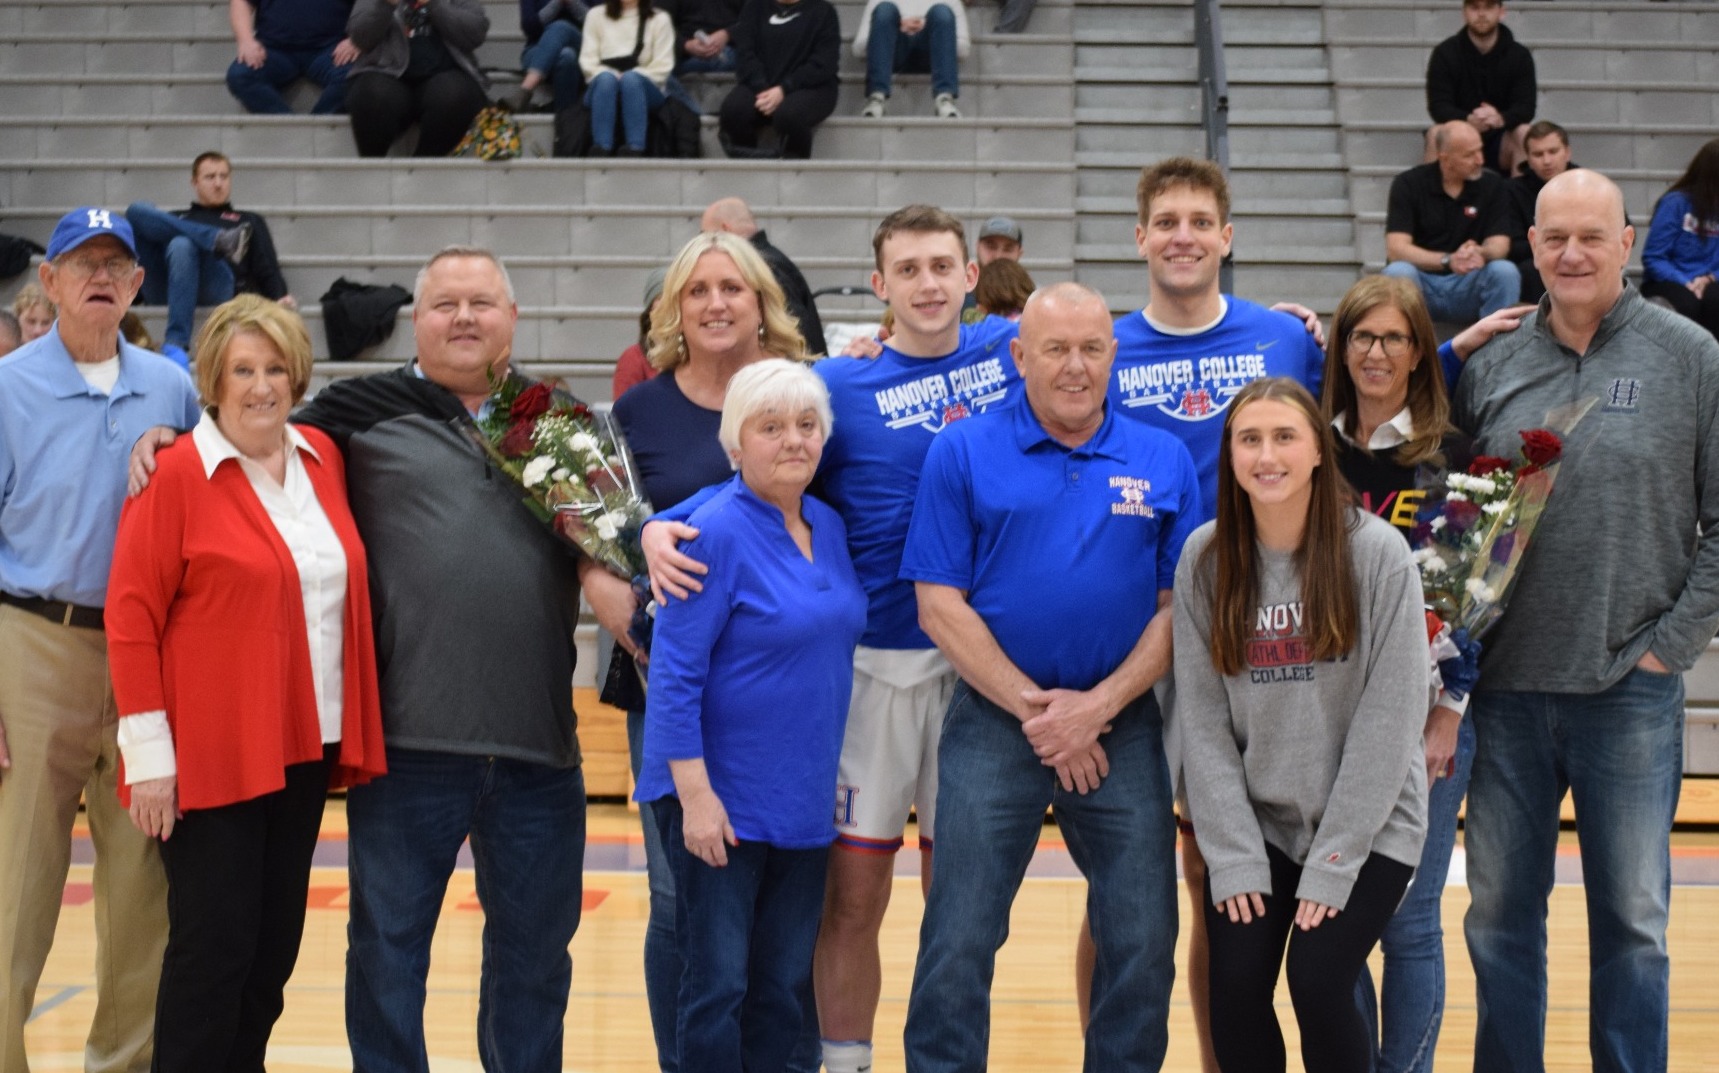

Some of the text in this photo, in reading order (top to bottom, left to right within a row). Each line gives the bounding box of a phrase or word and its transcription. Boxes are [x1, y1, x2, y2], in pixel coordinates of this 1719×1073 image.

[87, 209, 113, 229] H
[875, 373, 948, 415] HANOVER
[949, 358, 1006, 395] COLLEGE
[1118, 354, 1266, 393] HANOVER COLLEGE
[1109, 476, 1151, 492] HANOVER
[1112, 502, 1154, 518] BASKETBALL
[1362, 489, 1427, 528] VE
